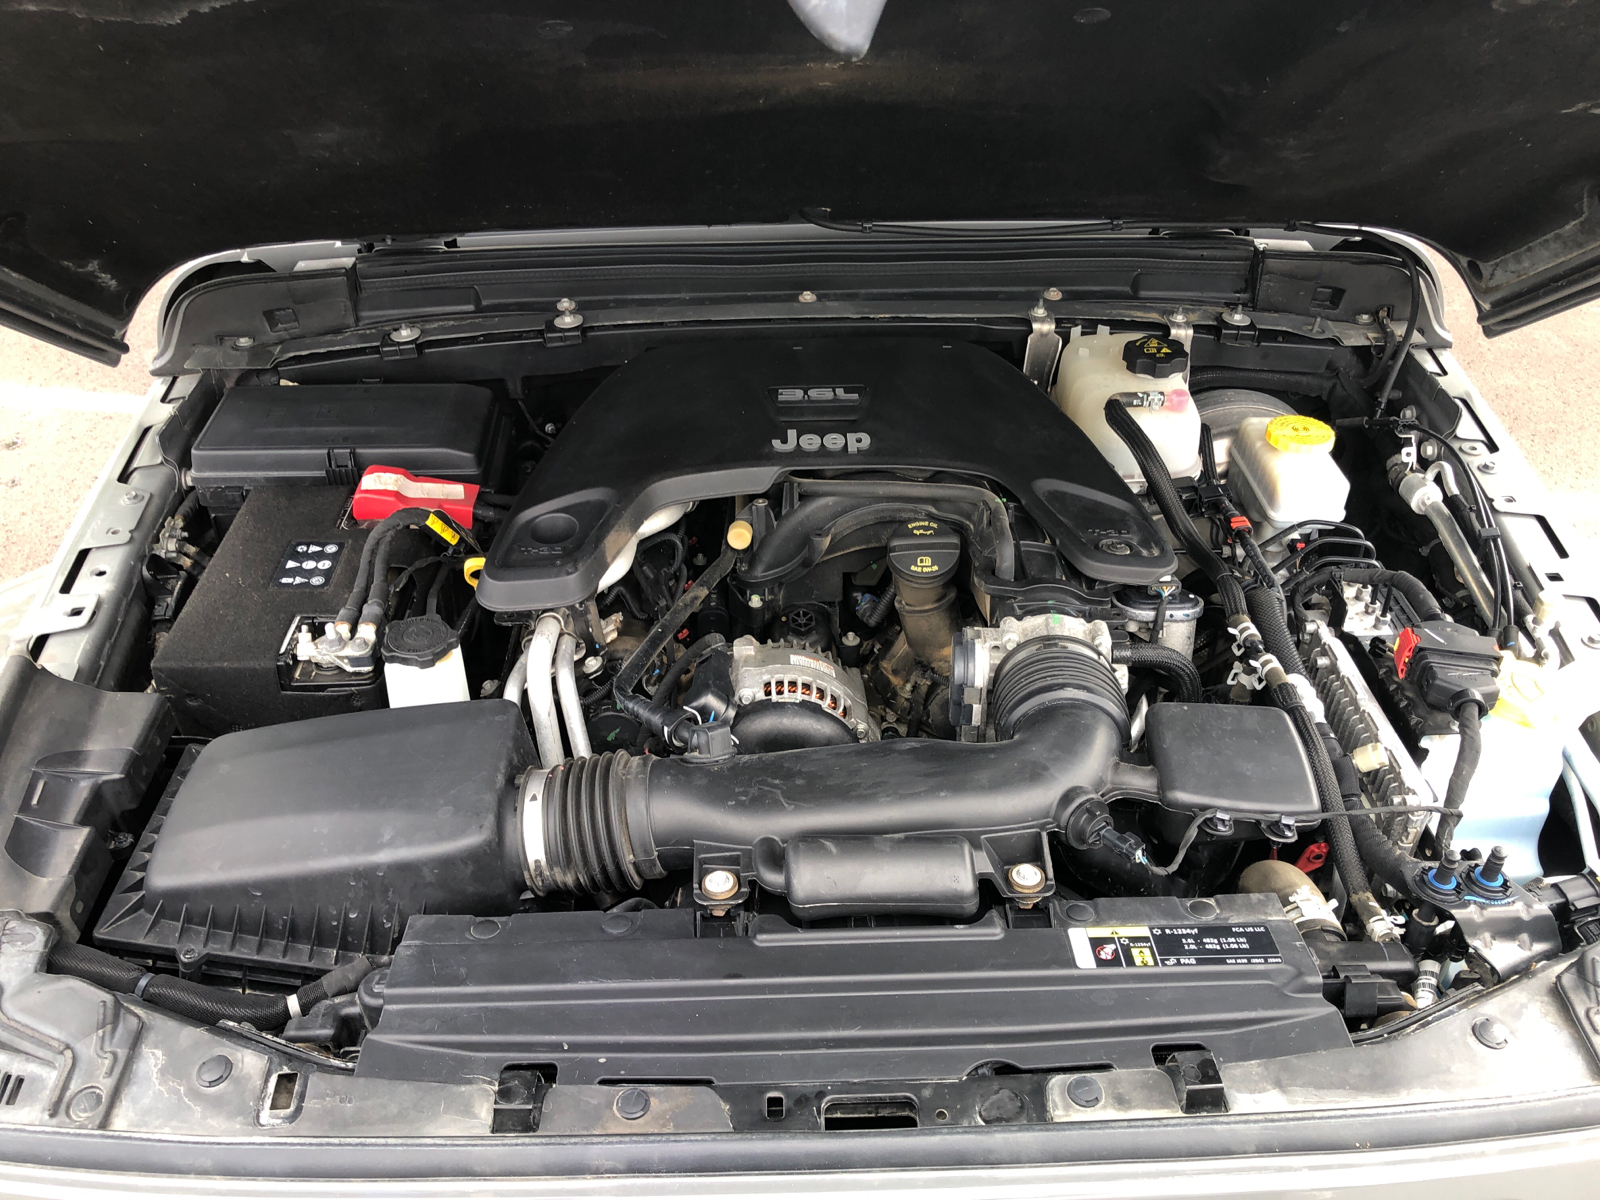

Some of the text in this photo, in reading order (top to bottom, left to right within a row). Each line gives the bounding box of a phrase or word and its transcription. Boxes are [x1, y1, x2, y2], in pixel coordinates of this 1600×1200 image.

[777, 387, 859, 401] 3.6L
[771, 428, 871, 454] Jeep
[907, 521, 938, 529] ENGINE OIL
[922, 565, 939, 573] 0W-20
[1165, 928, 1198, 936] R-1234yf
